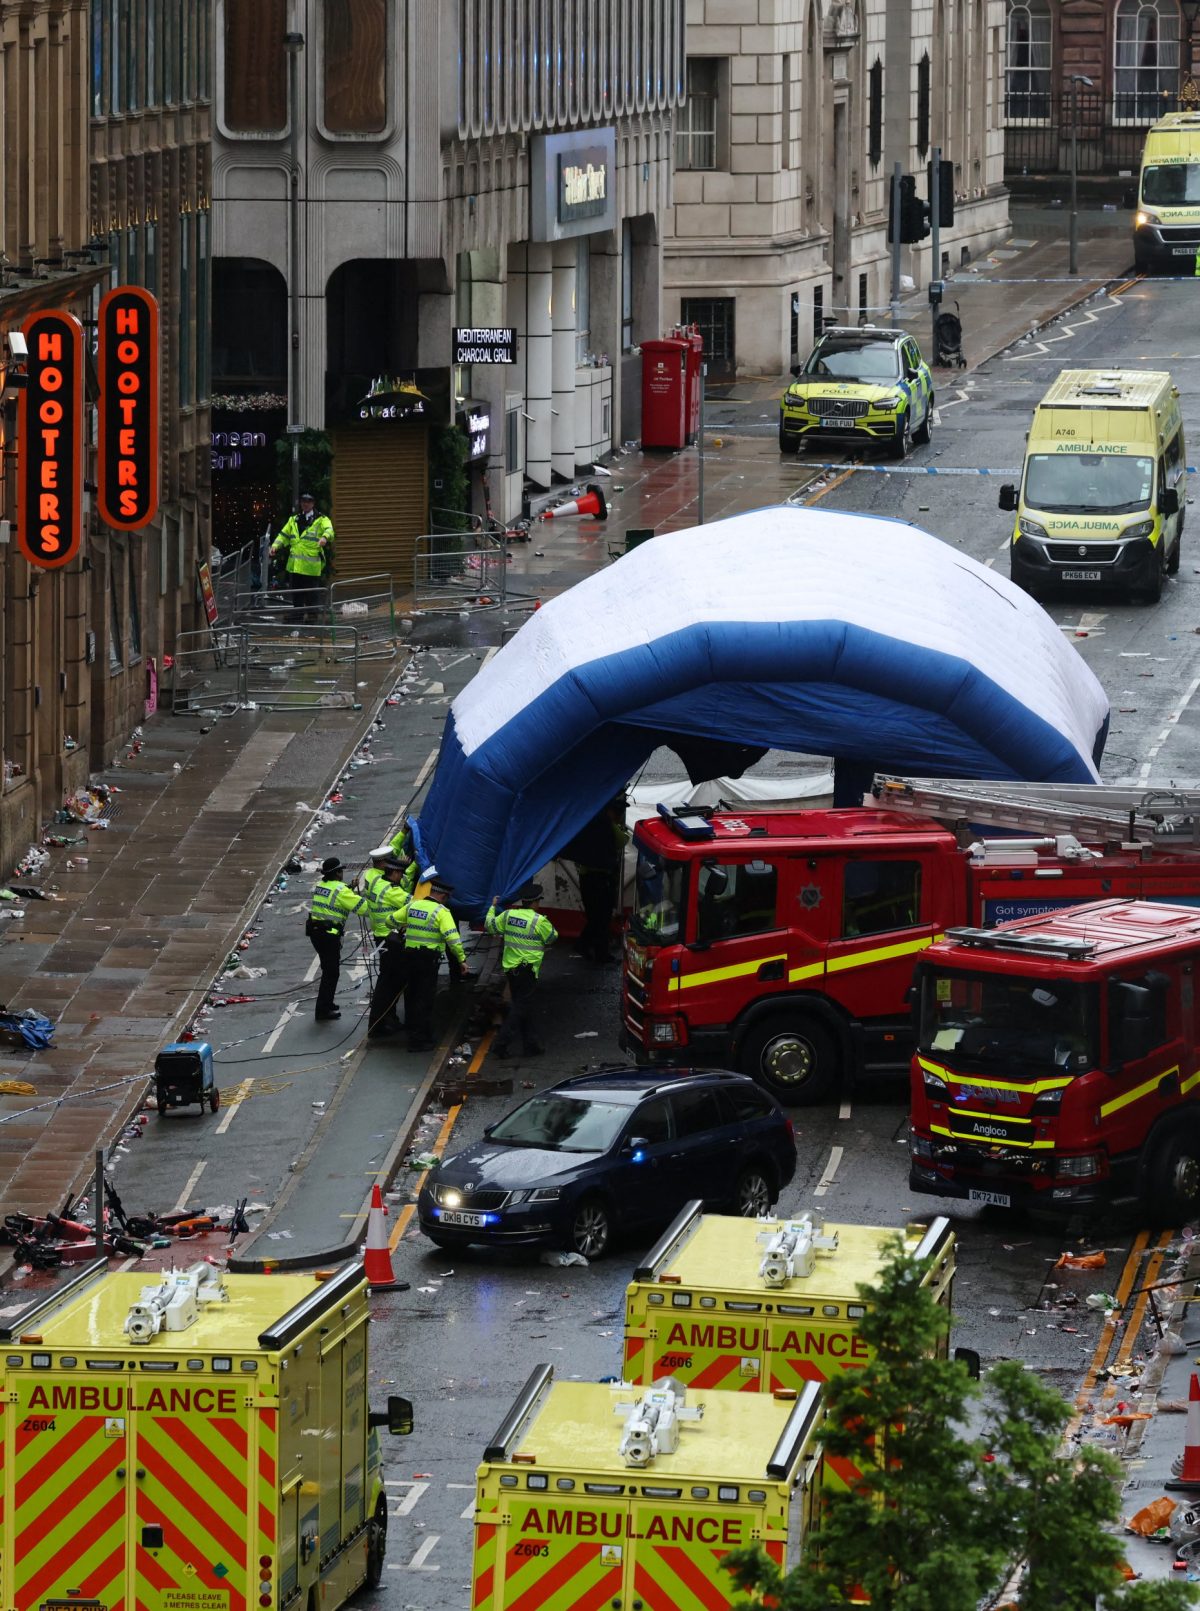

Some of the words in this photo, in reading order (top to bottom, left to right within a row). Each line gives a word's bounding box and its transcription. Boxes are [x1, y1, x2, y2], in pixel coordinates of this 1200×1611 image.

[457, 328, 512, 343] MEDITERRANEAN
[457, 347, 493, 362] CHARCOAL
[493, 348, 512, 362] GRILL
[116, 308, 140, 516] HOOTERS
[38, 333, 63, 553] HOOTERS
[1056, 444, 1128, 454] AMBULANCE
[1064, 571, 1083, 580] PK66
[1084, 571, 1098, 580] ECV
[315, 886, 331, 897] POLICE
[409, 908, 428, 920] POLICE
[995, 905, 1014, 915] Got
[508, 917, 527, 928] POLICE
[960, 1084, 1021, 1104] SCANIA
[973, 1123, 1007, 1137] Angloco
[971, 1190, 992, 1203] DK72
[993, 1195, 1008, 1206] AVU
[463, 1214, 480, 1225] CYS
[666, 1322, 869, 1359] AMBULANCE
[660, 1355, 693, 1368] Z606
[27, 1385, 237, 1413] AMBULANCE
[23, 1419, 57, 1432] Z604
[520, 1507, 743, 1545] AMBULANCE
[514, 1543, 550, 1557] Z603
[167, 1592, 196, 1600] PLEASE
[169, 1601, 201, 1609] METRES
